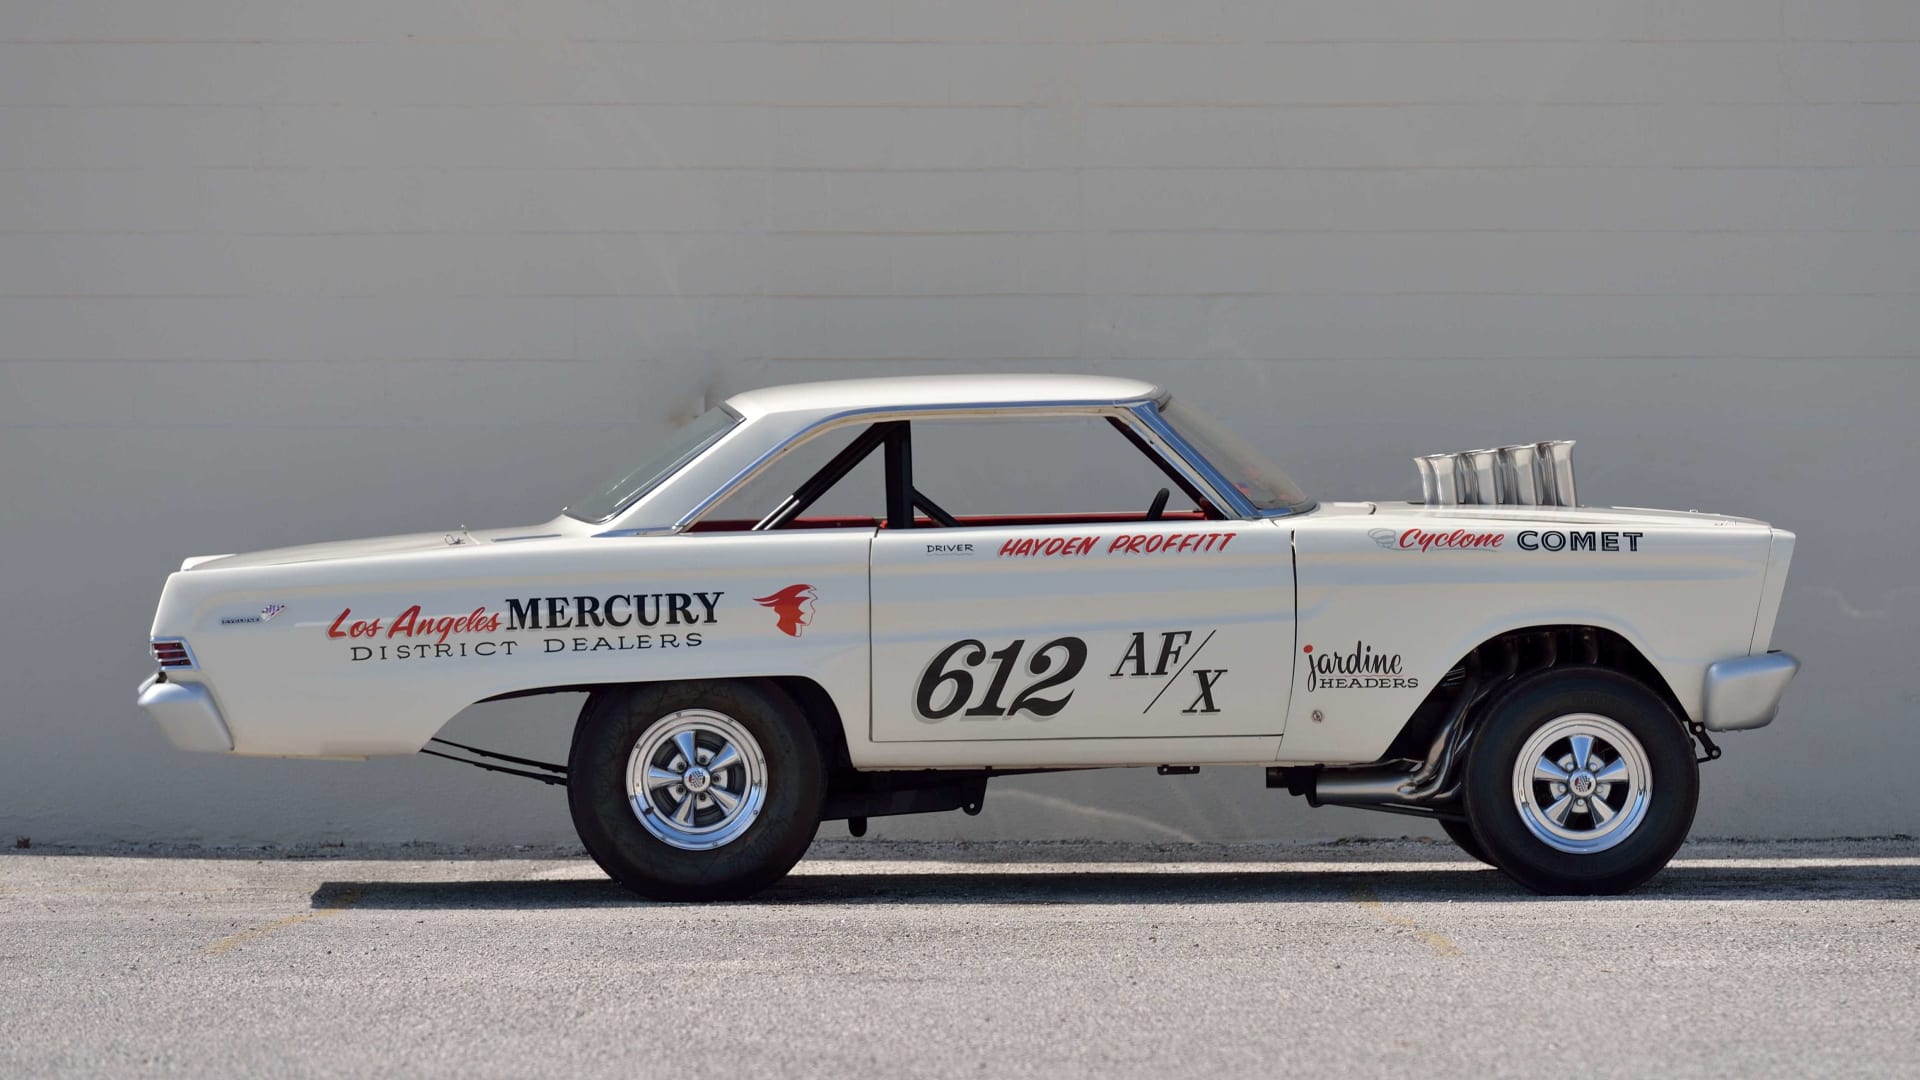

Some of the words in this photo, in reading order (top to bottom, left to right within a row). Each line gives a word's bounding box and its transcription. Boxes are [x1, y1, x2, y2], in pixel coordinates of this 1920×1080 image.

[926, 543, 974, 553] DRIVER
[999, 535, 1101, 557] HAYDEN
[1108, 532, 1236, 555] PROFFITT
[1398, 528, 1505, 553] Cyclone
[1517, 531, 1644, 552] COMET
[327, 607, 383, 639] Los
[387, 604, 502, 645] Angeles
[505, 592, 725, 630] MERCURY
[350, 640, 519, 661] DISTRICT
[543, 632, 704, 653] DEALERS
[916, 636, 1088, 720] 612
[1303, 640, 1403, 692] jardine
[1319, 677, 1419, 689] HEADERS
